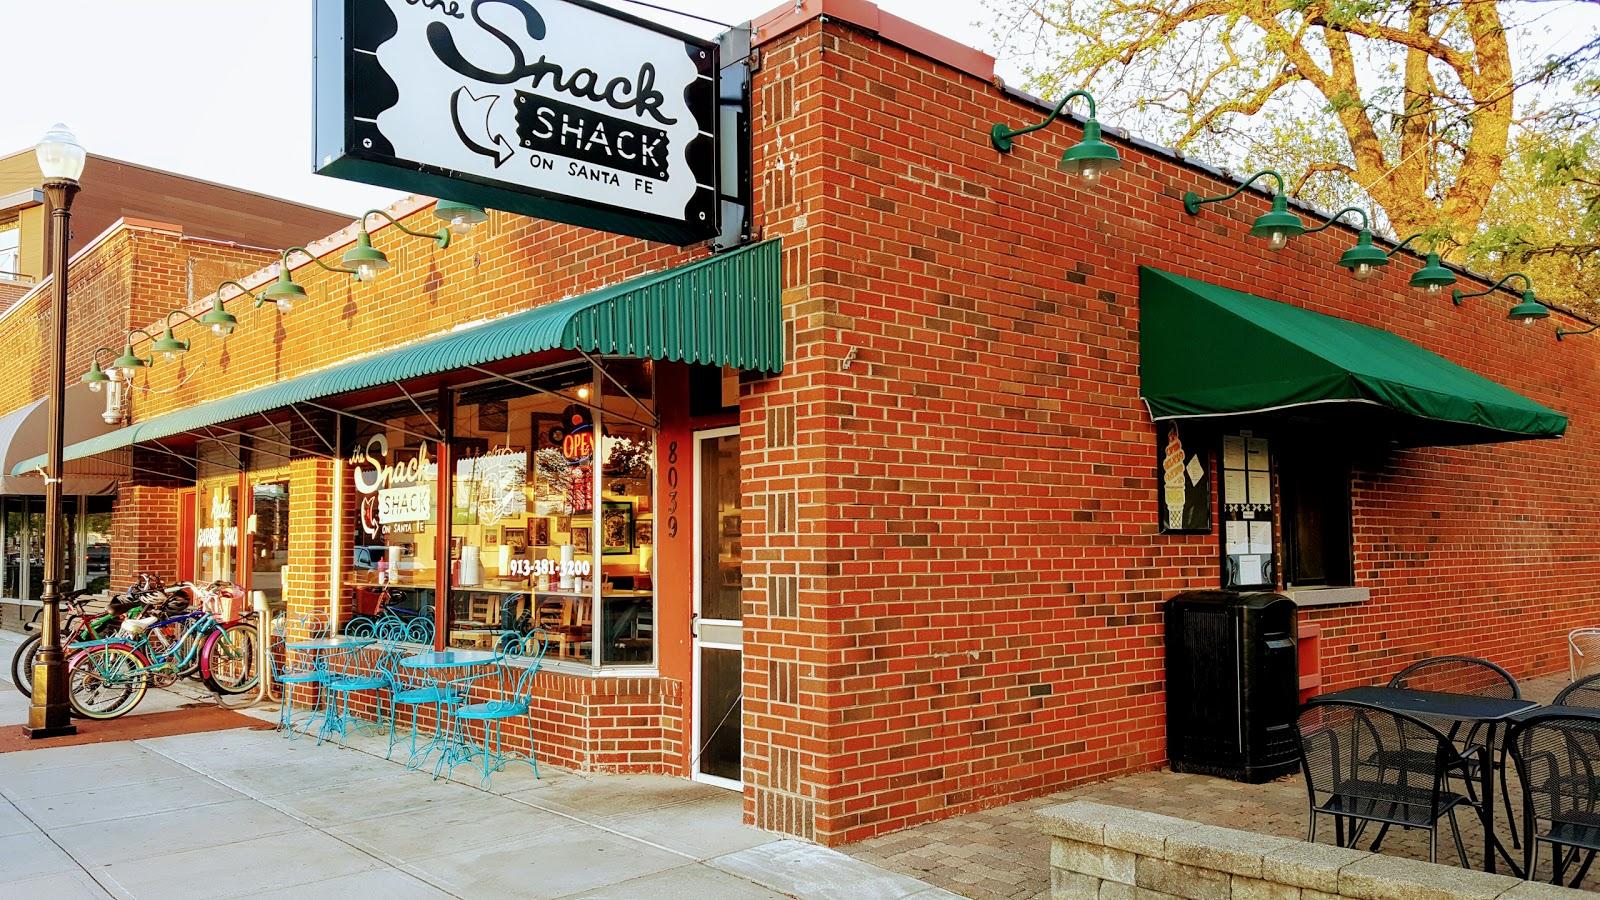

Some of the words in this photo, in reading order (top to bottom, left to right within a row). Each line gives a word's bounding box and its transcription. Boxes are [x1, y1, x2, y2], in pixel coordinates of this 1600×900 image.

[427, 0, 678, 125] Snack
[532, 106, 663, 168] SHACK
[530, 154, 554, 171] ON
[568, 162, 621, 187] SANTA
[635, 180, 653, 194] FE
[349, 444, 365, 464] the
[354, 433, 430, 494] Snack
[383, 492, 427, 515] SHACK
[668, 441, 678, 538] 8039
[382, 525, 392, 535] ON
[394, 523, 412, 534] SANTA
[510, 559, 590, 576] 913-381-3200
